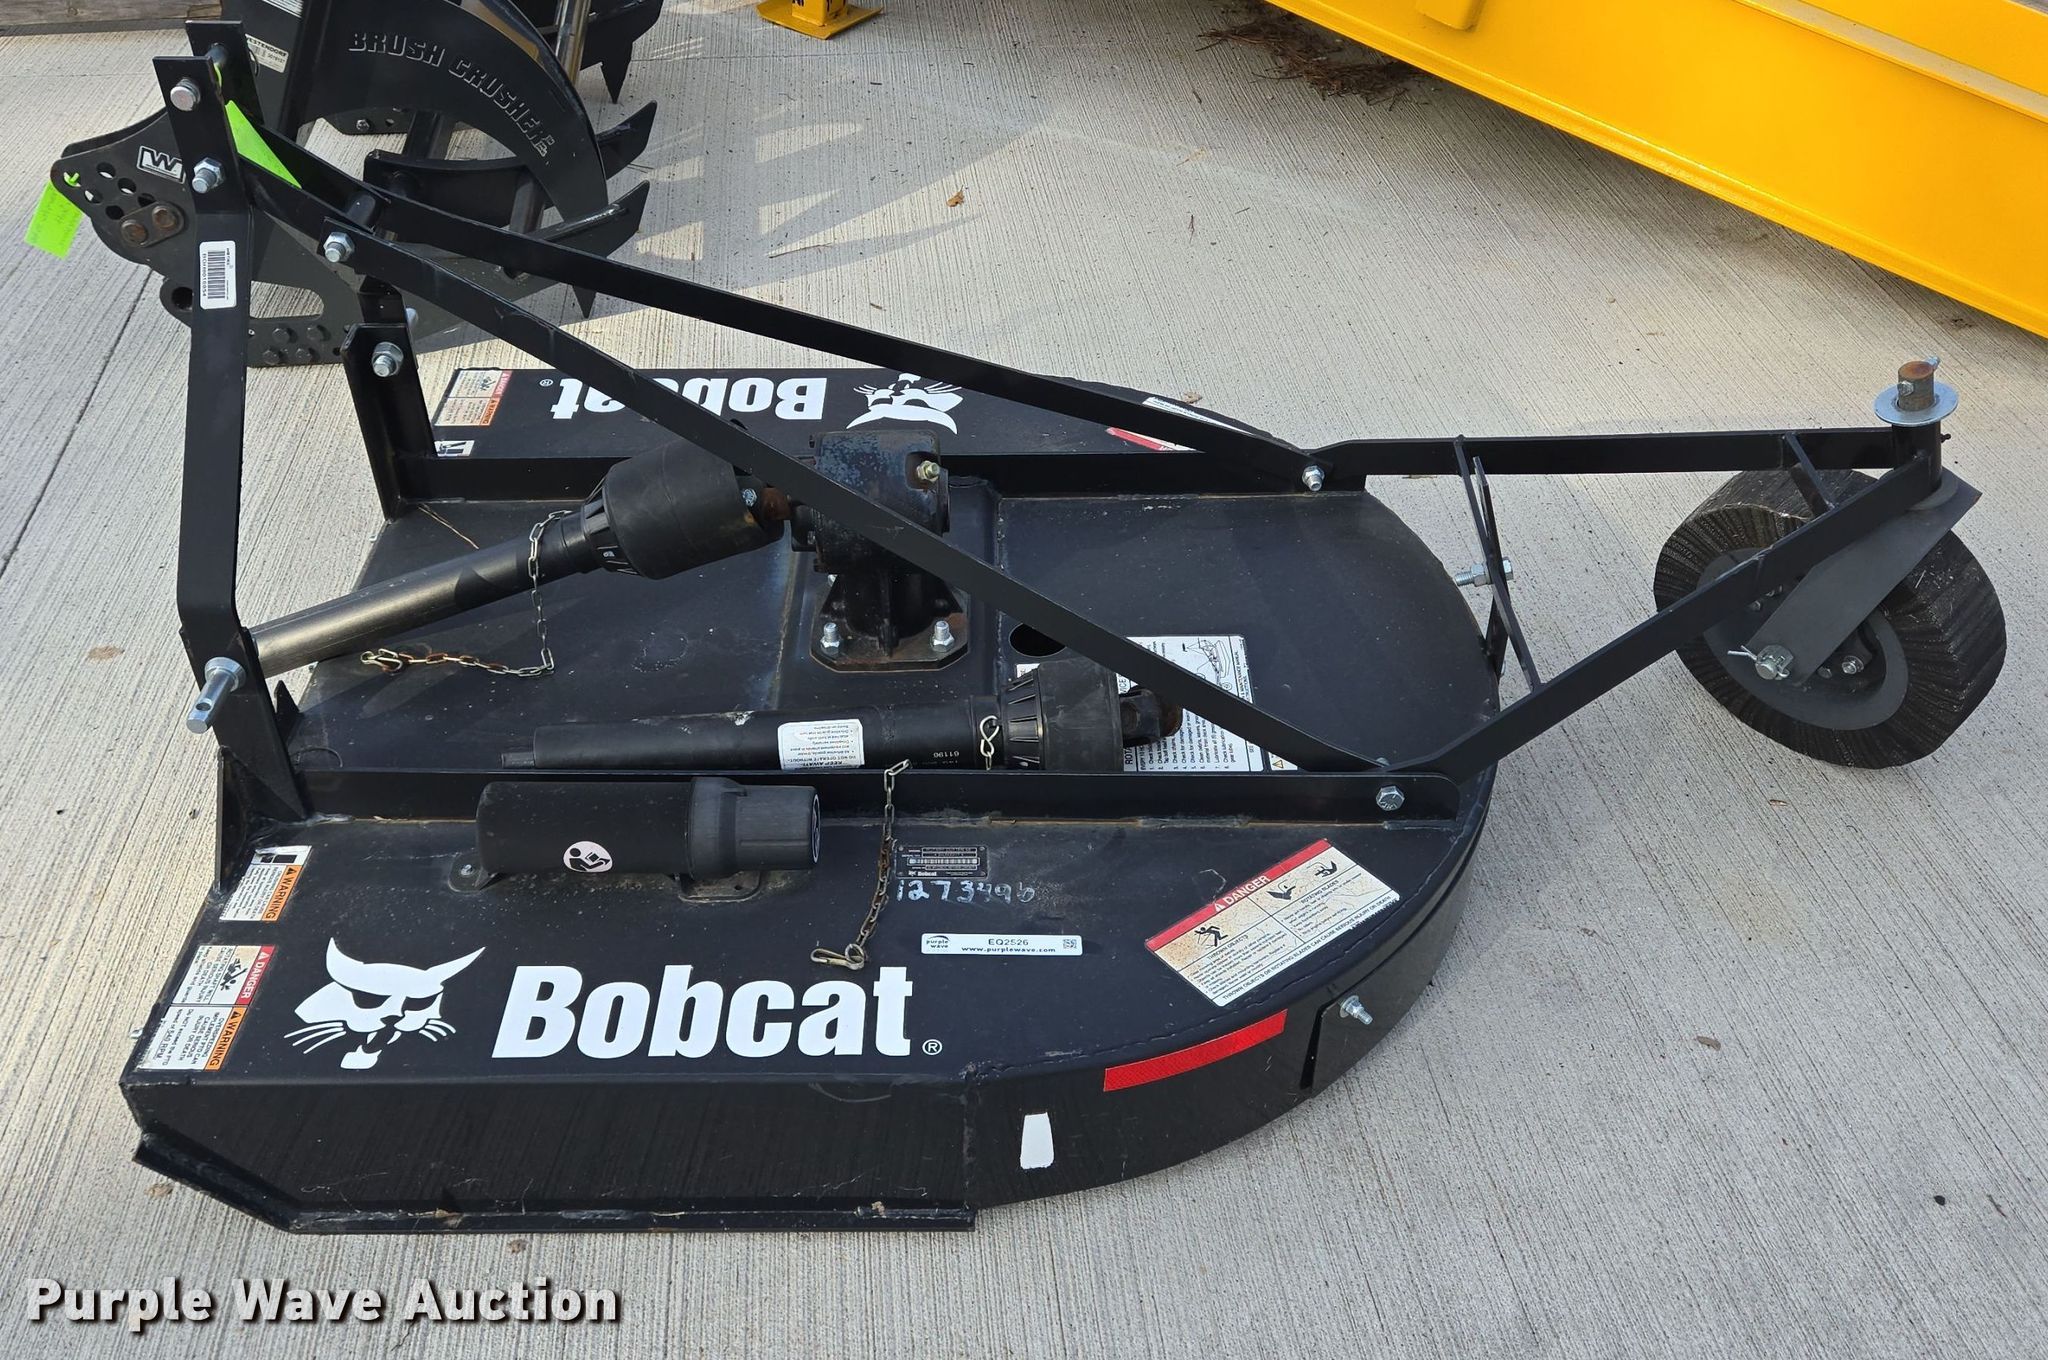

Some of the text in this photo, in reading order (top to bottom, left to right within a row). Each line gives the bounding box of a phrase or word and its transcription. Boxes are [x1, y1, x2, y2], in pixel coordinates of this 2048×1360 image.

[349, 33, 445, 67] BRUSH
[265, 877, 294, 918] WARNING
[1224, 875, 1271, 906] DANGER
[988, 938, 1029, 946] EQ2526
[238, 961, 267, 998] DANGER
[491, 965, 913, 1059] Bobcat
[207, 1021, 239, 1065] WARNING
